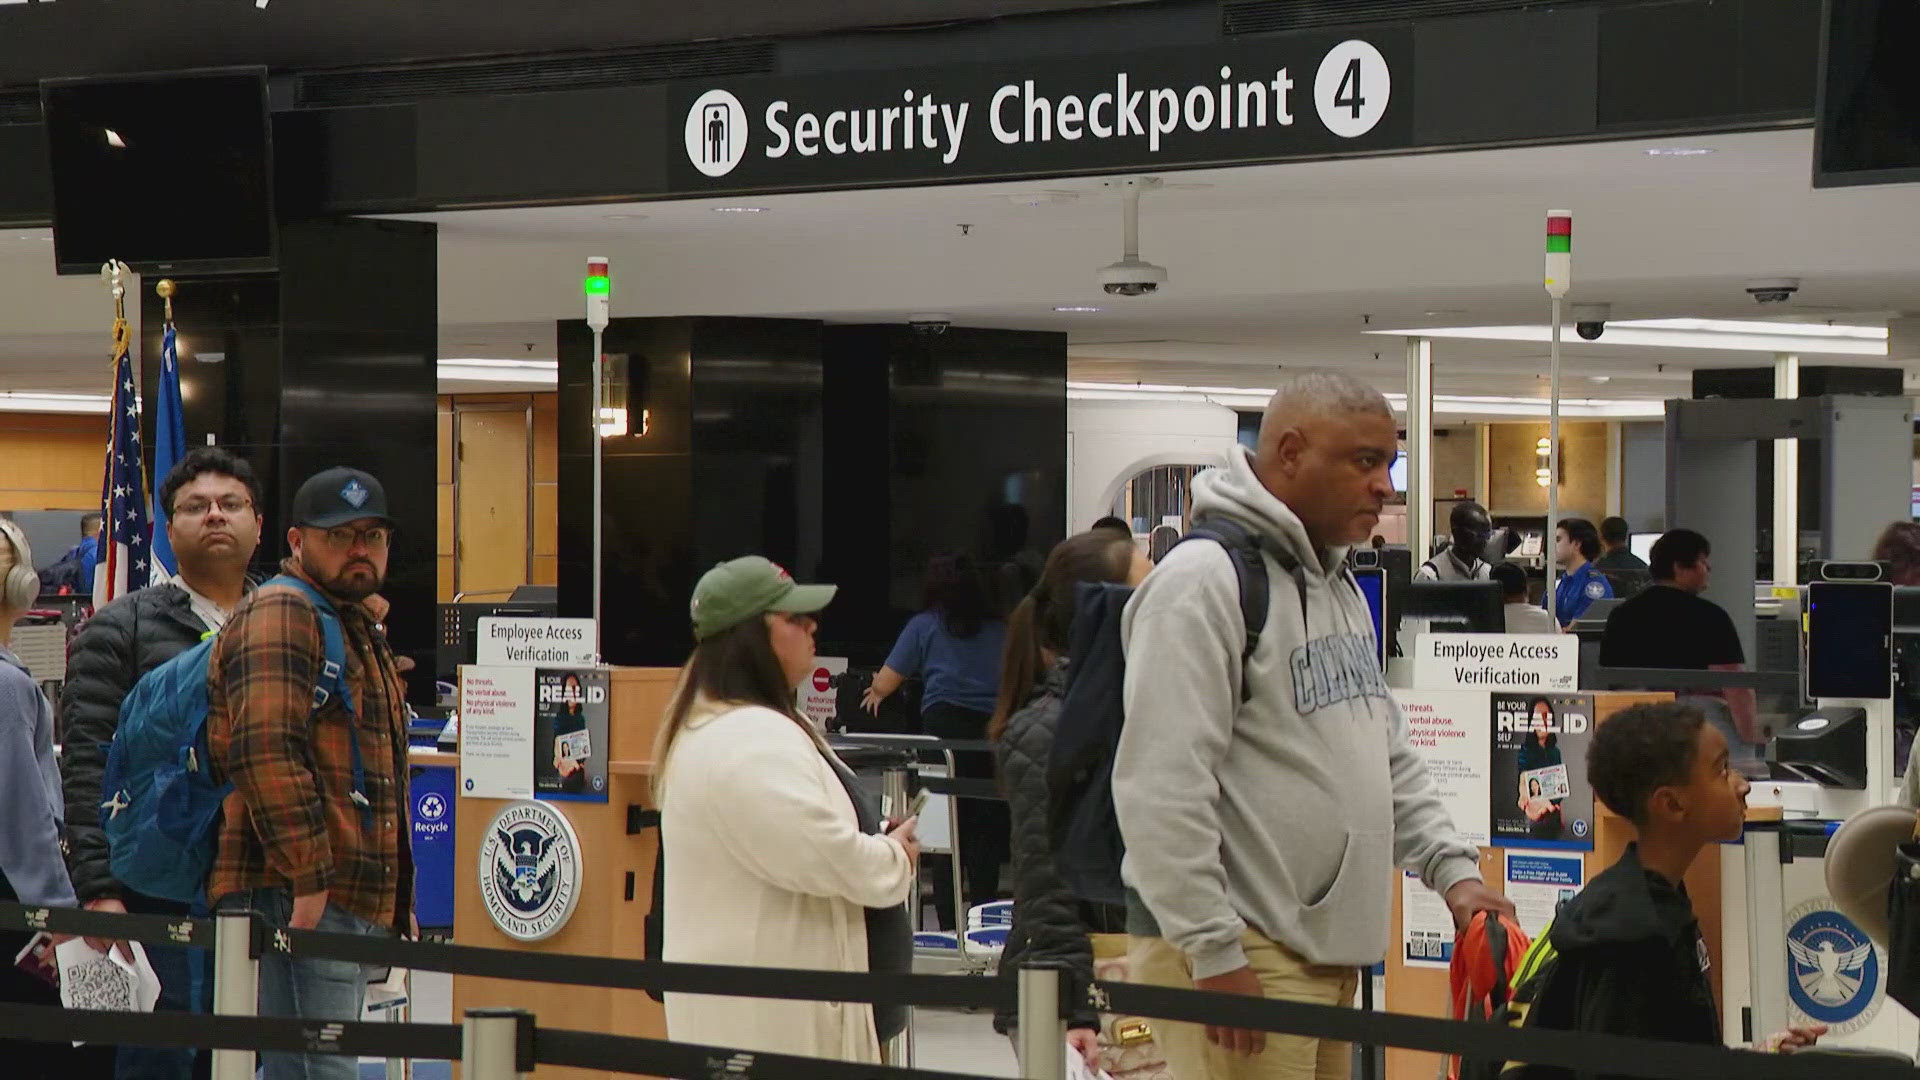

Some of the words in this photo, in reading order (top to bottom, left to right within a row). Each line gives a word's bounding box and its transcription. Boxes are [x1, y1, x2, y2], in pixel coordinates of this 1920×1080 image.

[765, 88, 970, 165] Security
[989, 65, 1295, 153] Checkpoint
[1333, 57, 1367, 120] 4
[491, 623, 543, 642] Employee
[546, 624, 583, 641] Access
[506, 645, 569, 662] Verification
[1433, 640, 1504, 662] Employee
[1509, 642, 1559, 660] Access
[1454, 666, 1540, 685] Verification
[539, 684, 586, 703] REAL
[587, 685, 605, 704] ID
[1409, 703, 1435, 712] threats.
[1497, 701, 1506, 710] BE
[1506, 701, 1527, 711] YOUR
[1409, 716, 1431, 725] verbal
[1431, 716, 1454, 726] abuse.
[1497, 711, 1561, 733] REAL
[1563, 712, 1588, 735] ID
[1409, 728, 1437, 738] physical
[1437, 729, 1466, 738] violence
[1497, 733, 1512, 742] SELF
[1420, 738, 1438, 747] kind.
[415, 821, 449, 834] Recycle
[499, 807, 564, 842] DEPARTMENT
[560, 844, 571, 865] OF
[483, 874, 527, 935] HOMELAND
[531, 879, 571, 935] SECURITY
